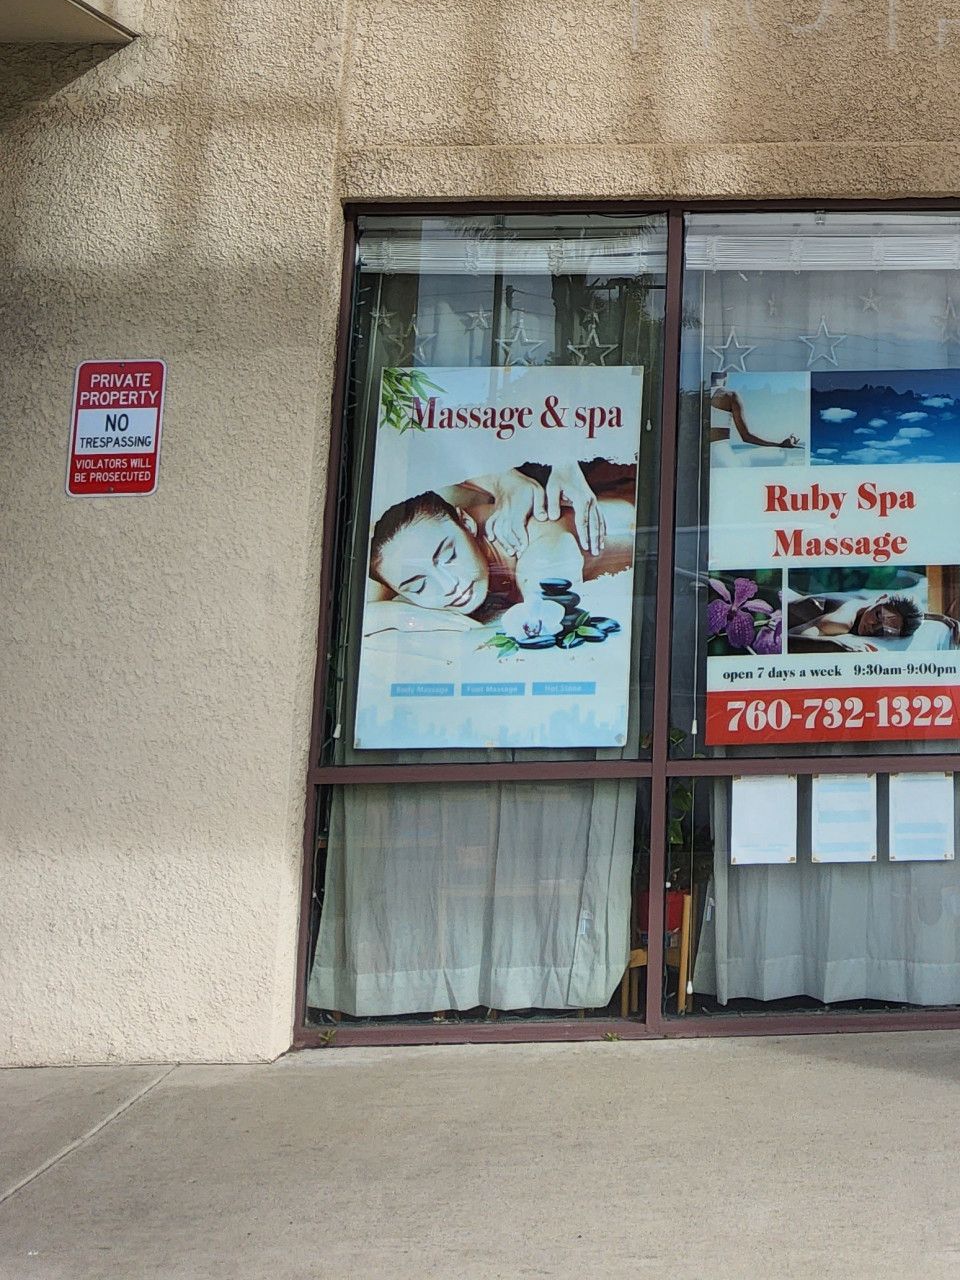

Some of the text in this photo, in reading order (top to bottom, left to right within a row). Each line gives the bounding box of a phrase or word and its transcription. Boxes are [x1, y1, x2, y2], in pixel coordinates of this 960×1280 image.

[90, 373, 151, 388] PRIVATE
[80, 391, 159, 406] PROPERTY
[105, 414, 129, 432] NO
[409, 395, 624, 440] Massage & spa
[80, 436, 151, 449] TRESPASSING
[76, 458, 151, 470] VIOLATORS WILL
[74, 471, 151, 483] BE PROSECUTED
[764, 482, 917, 520] Ruby Spa
[772, 529, 909, 563] Massage
[722, 670, 754, 683] open
[757, 667, 765, 679] 7
[767, 666, 796, 682] days
[799, 668, 807, 677] a
[810, 665, 842, 677] week
[727, 695, 953, 732] 760-732-1322
